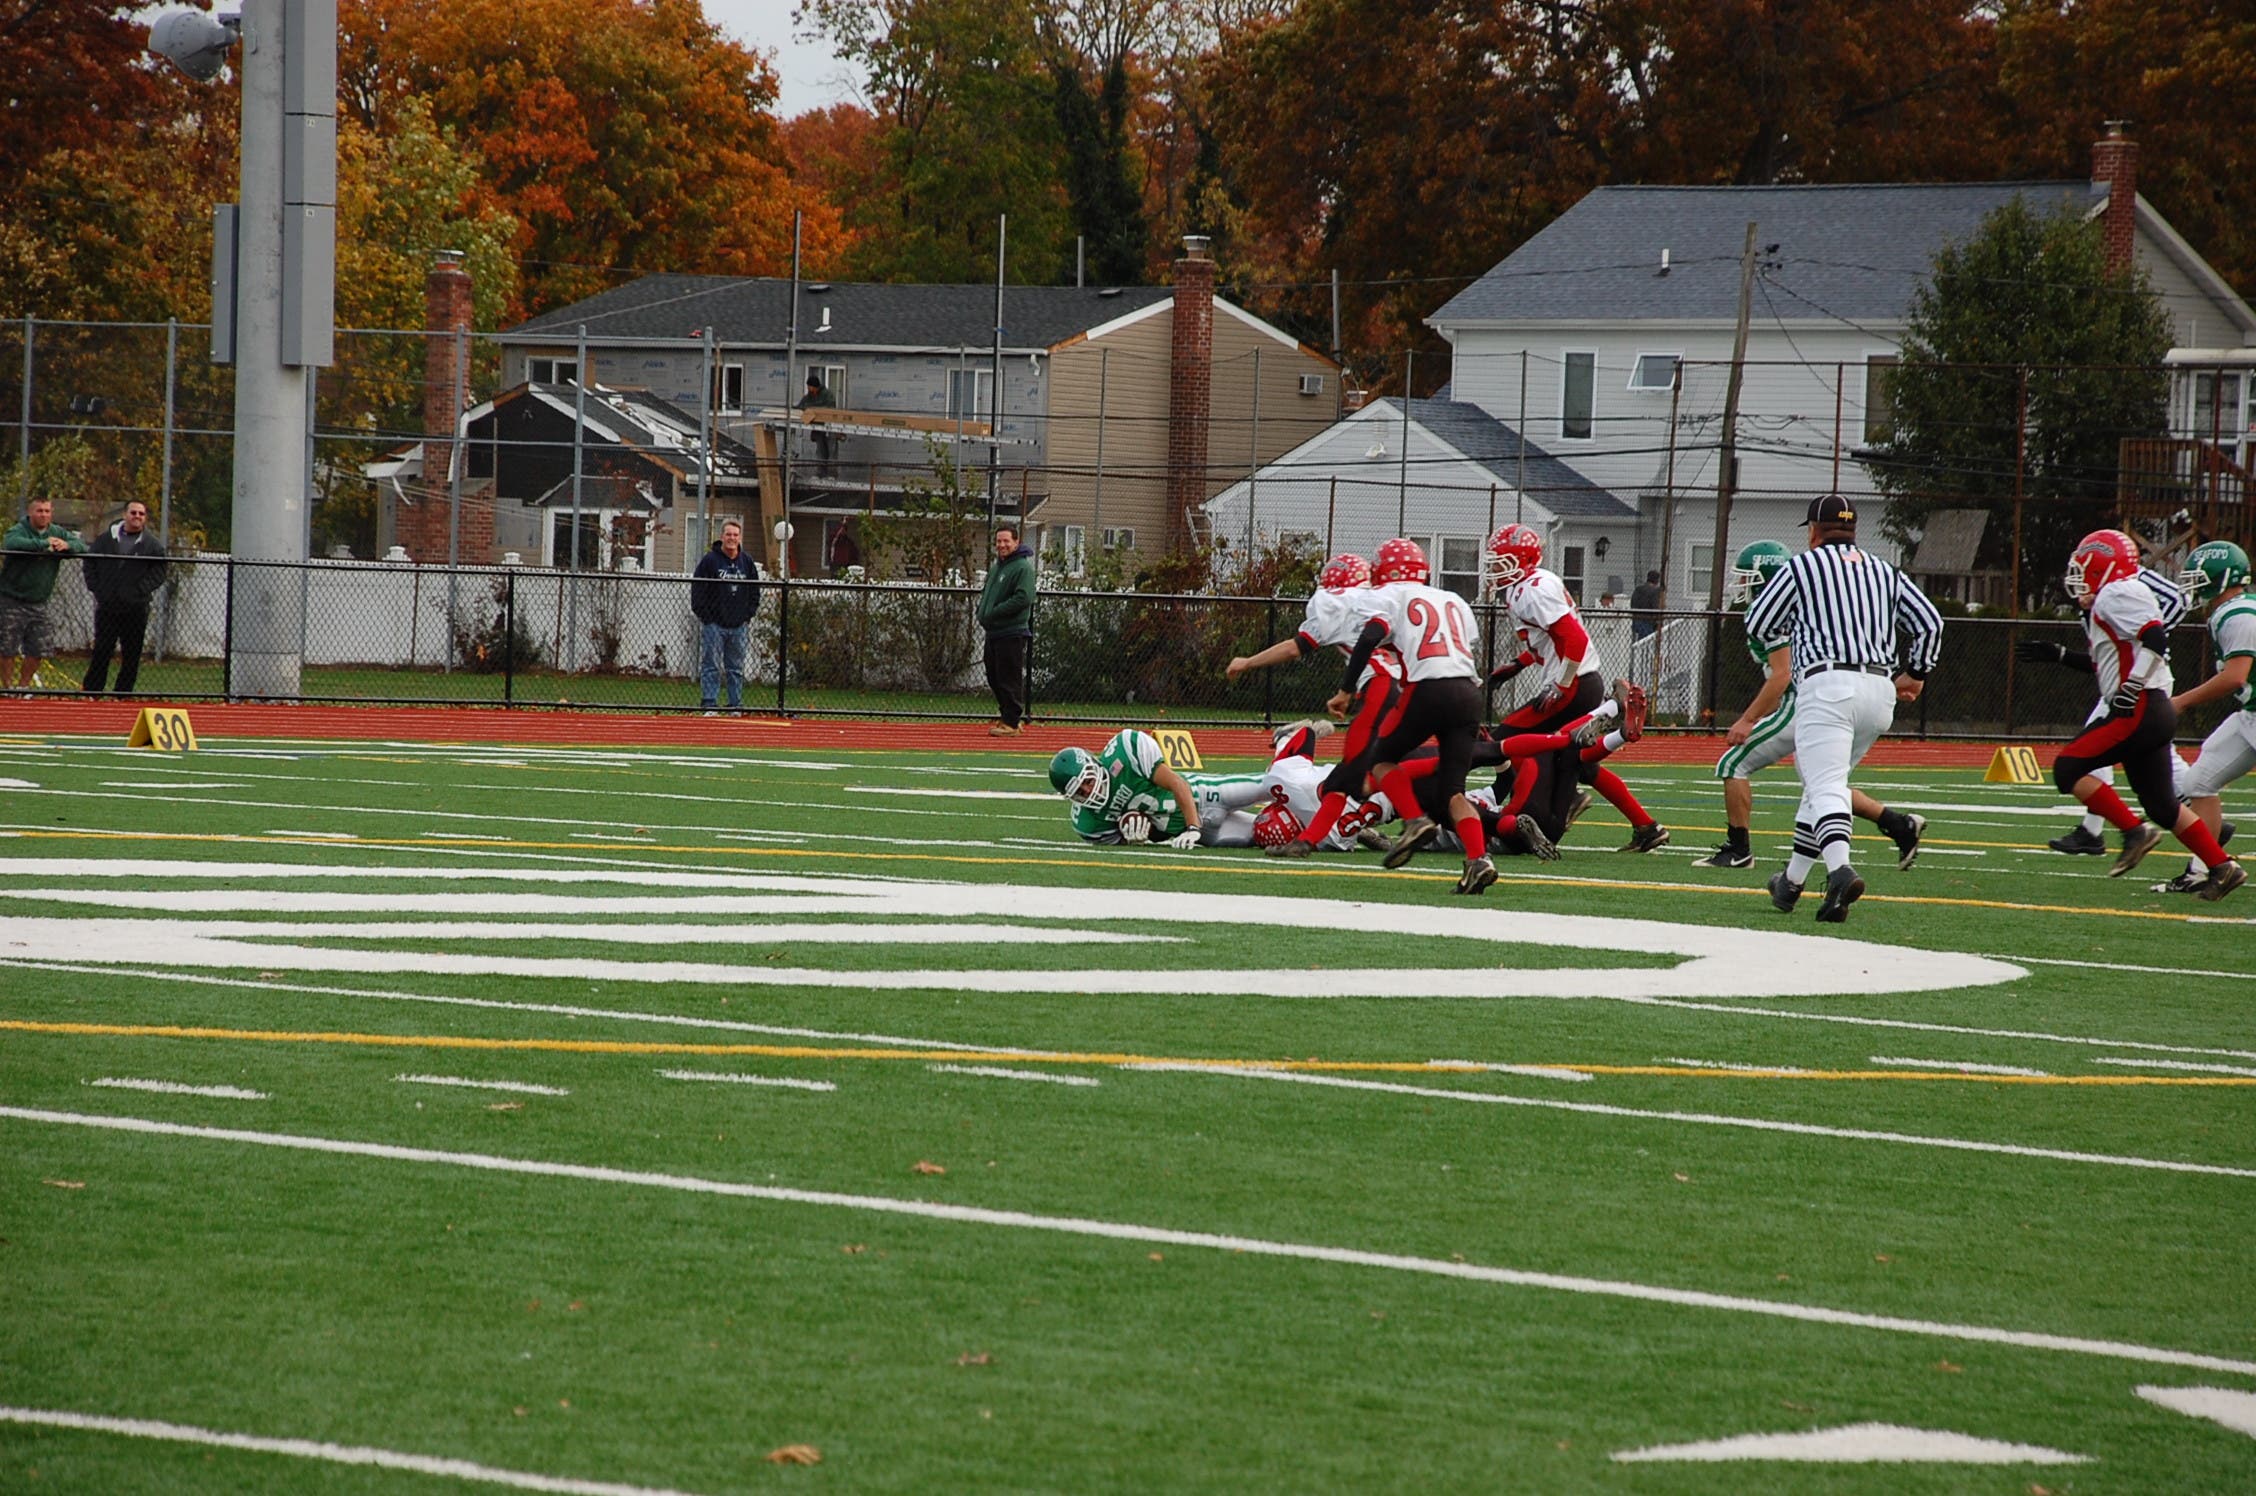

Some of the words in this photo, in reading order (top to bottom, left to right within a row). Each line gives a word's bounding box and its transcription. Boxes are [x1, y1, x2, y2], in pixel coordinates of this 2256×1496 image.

[1752, 554, 1786, 567] SAFORD
[1407, 597, 1474, 661] 20
[154, 712, 190, 751] 30
[1163, 734, 1196, 769] 20
[2005, 747, 2040, 782] 10
